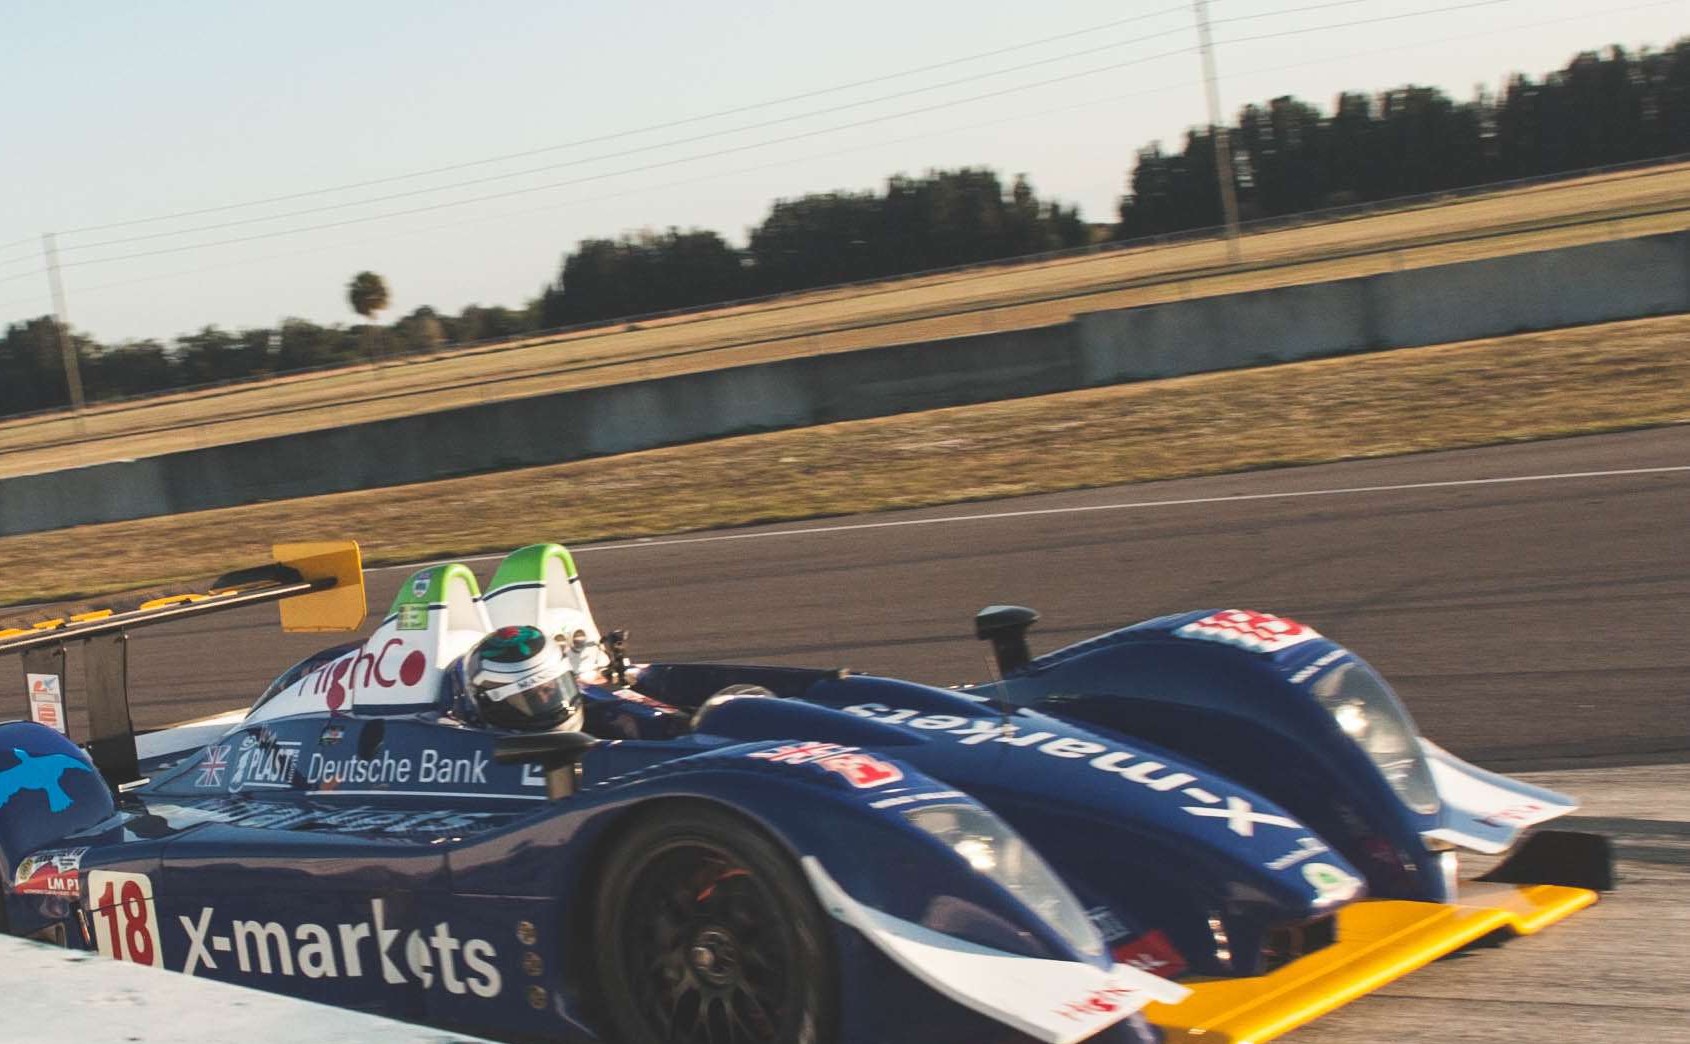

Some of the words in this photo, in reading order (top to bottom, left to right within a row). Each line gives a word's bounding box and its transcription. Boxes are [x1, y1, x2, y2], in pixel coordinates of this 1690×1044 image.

[308, 751, 412, 785] Deutsche
[419, 749, 489, 785] Bank
[47, 877, 65, 890] LM
[99, 880, 154, 967] 18
